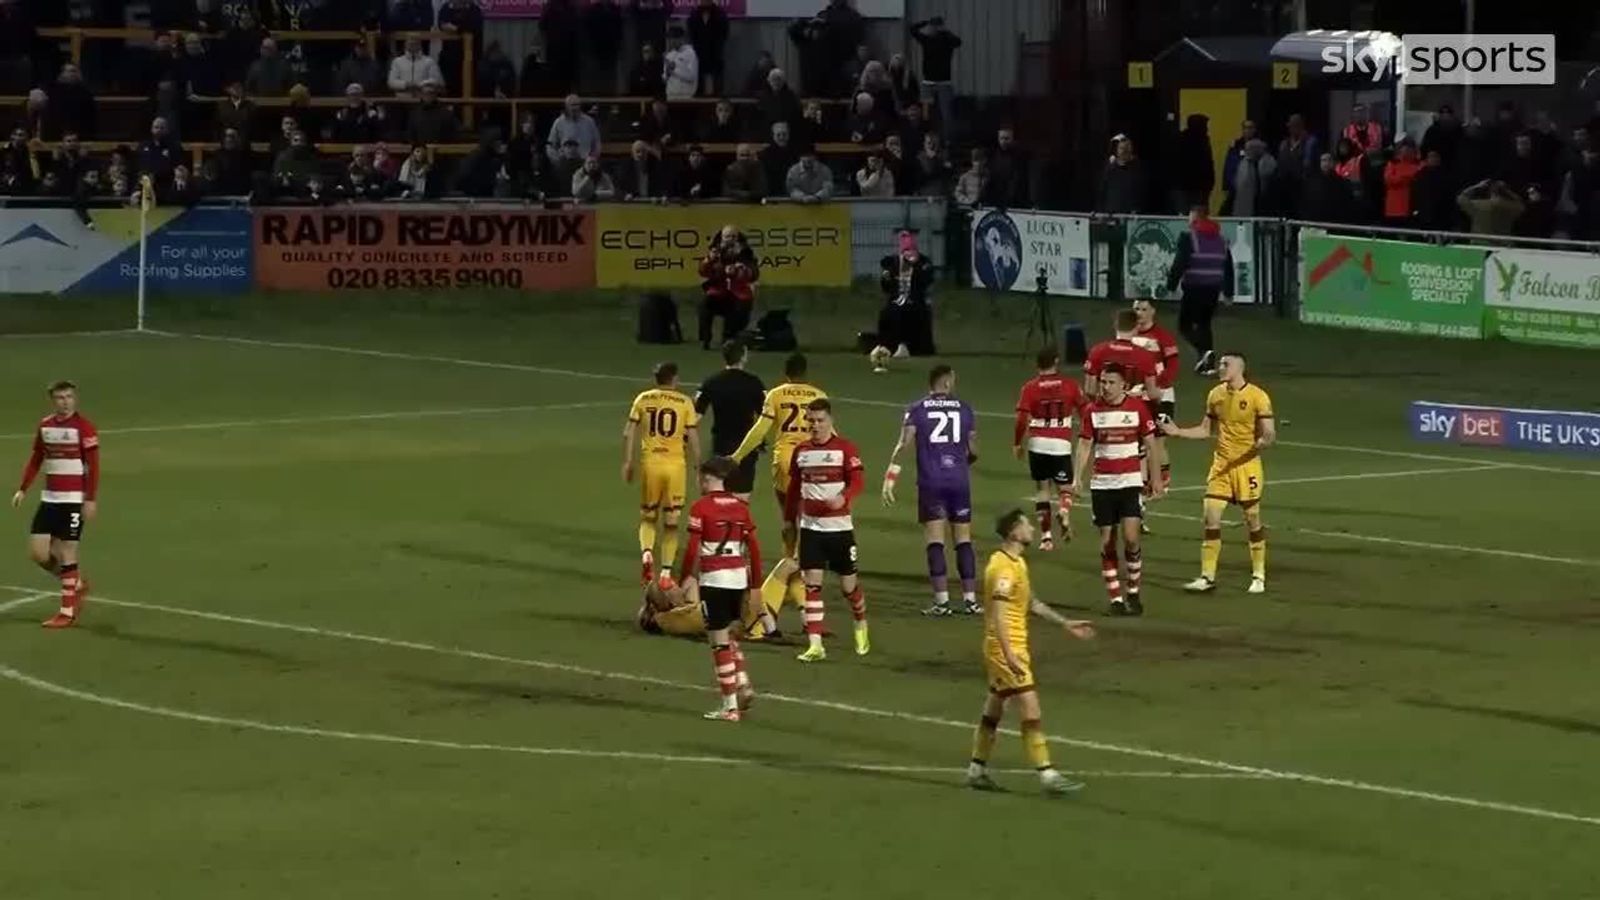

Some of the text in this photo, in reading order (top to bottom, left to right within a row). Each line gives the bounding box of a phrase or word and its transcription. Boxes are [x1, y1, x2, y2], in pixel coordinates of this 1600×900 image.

[1136, 67, 1145, 83] 1
[1280, 68, 1290, 84] 2
[261, 214, 585, 246] RAPID READYMIX
[1026, 220, 1065, 236] LUCKY
[601, 229, 700, 250] ECHO
[161, 245, 246, 264] For all your
[1031, 240, 1062, 256] STAR
[281, 251, 568, 263] QUALITY CONCRETE AND SCREED
[633, 257, 684, 271] BPH
[120, 263, 246, 280] Roofing Supplies
[1034, 261, 1058, 276] GIN
[1401, 262, 1443, 277] ROOFING
[1455, 267, 1482, 280] LOFT
[327, 268, 523, 289] 020 8335 9900
[1408, 276, 1474, 292] CONVERSION
[1519, 271, 1579, 299] Falcon
[1411, 289, 1469, 305] SPECIALIST
[645, 406, 677, 438] 10
[928, 412, 961, 443] 21
[1420, 411, 1600, 446] sky bet THE UK'S
[1248, 476, 1258, 490] 5
[70, 512, 80, 528] 3
